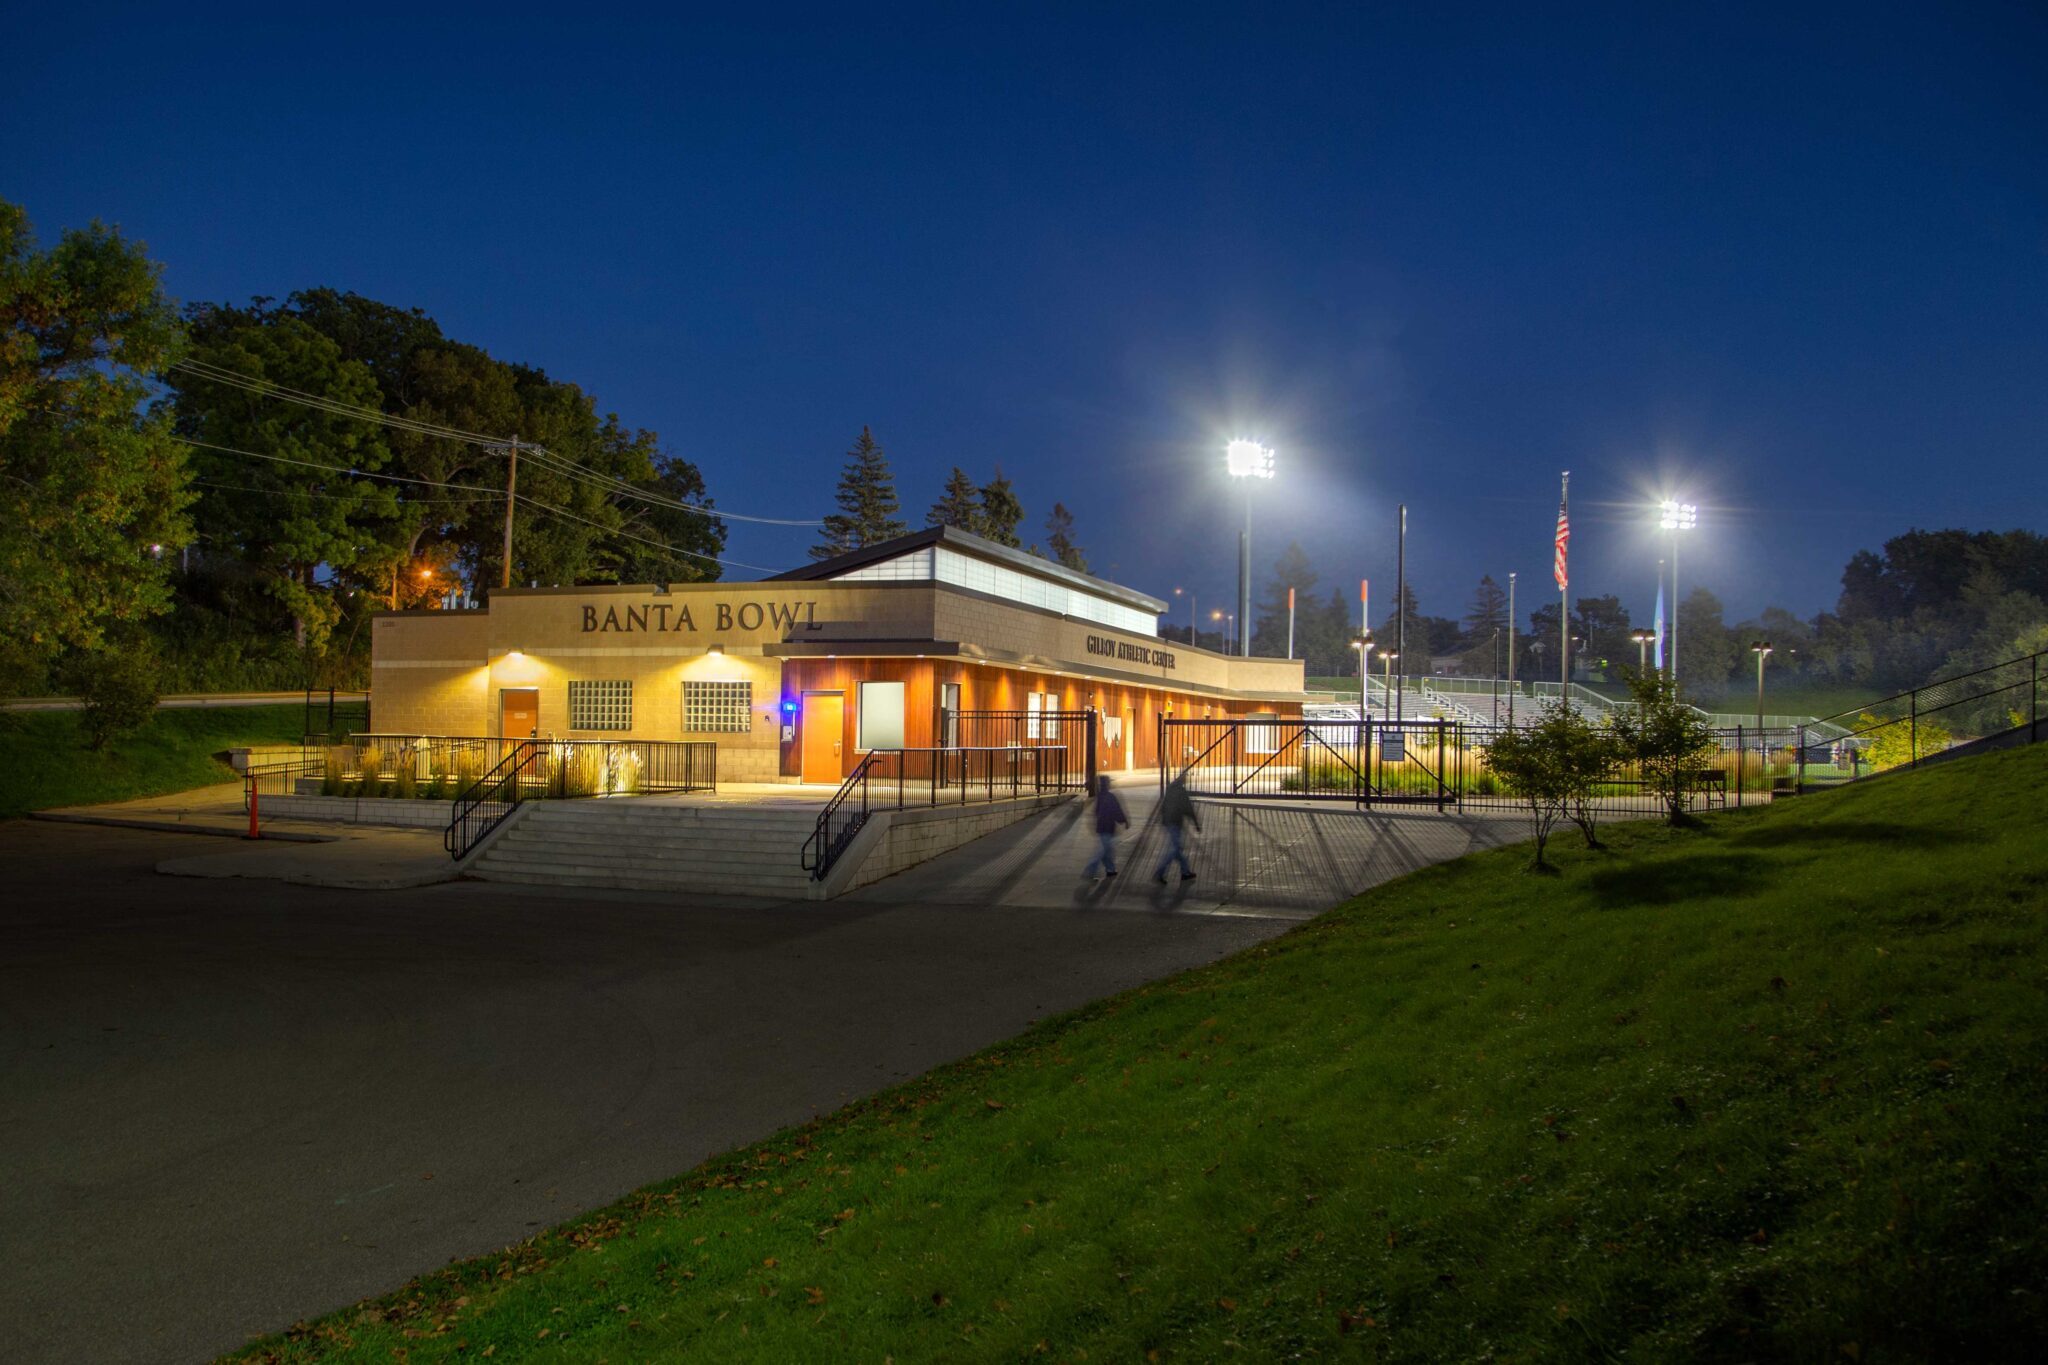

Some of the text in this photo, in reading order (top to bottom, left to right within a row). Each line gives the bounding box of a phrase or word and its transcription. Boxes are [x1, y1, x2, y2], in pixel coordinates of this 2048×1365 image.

[581, 602, 823, 633] BANTA BOWL
[1118, 642, 1151, 665] ATHLETIC
[1152, 650, 1176, 669] CENTER
